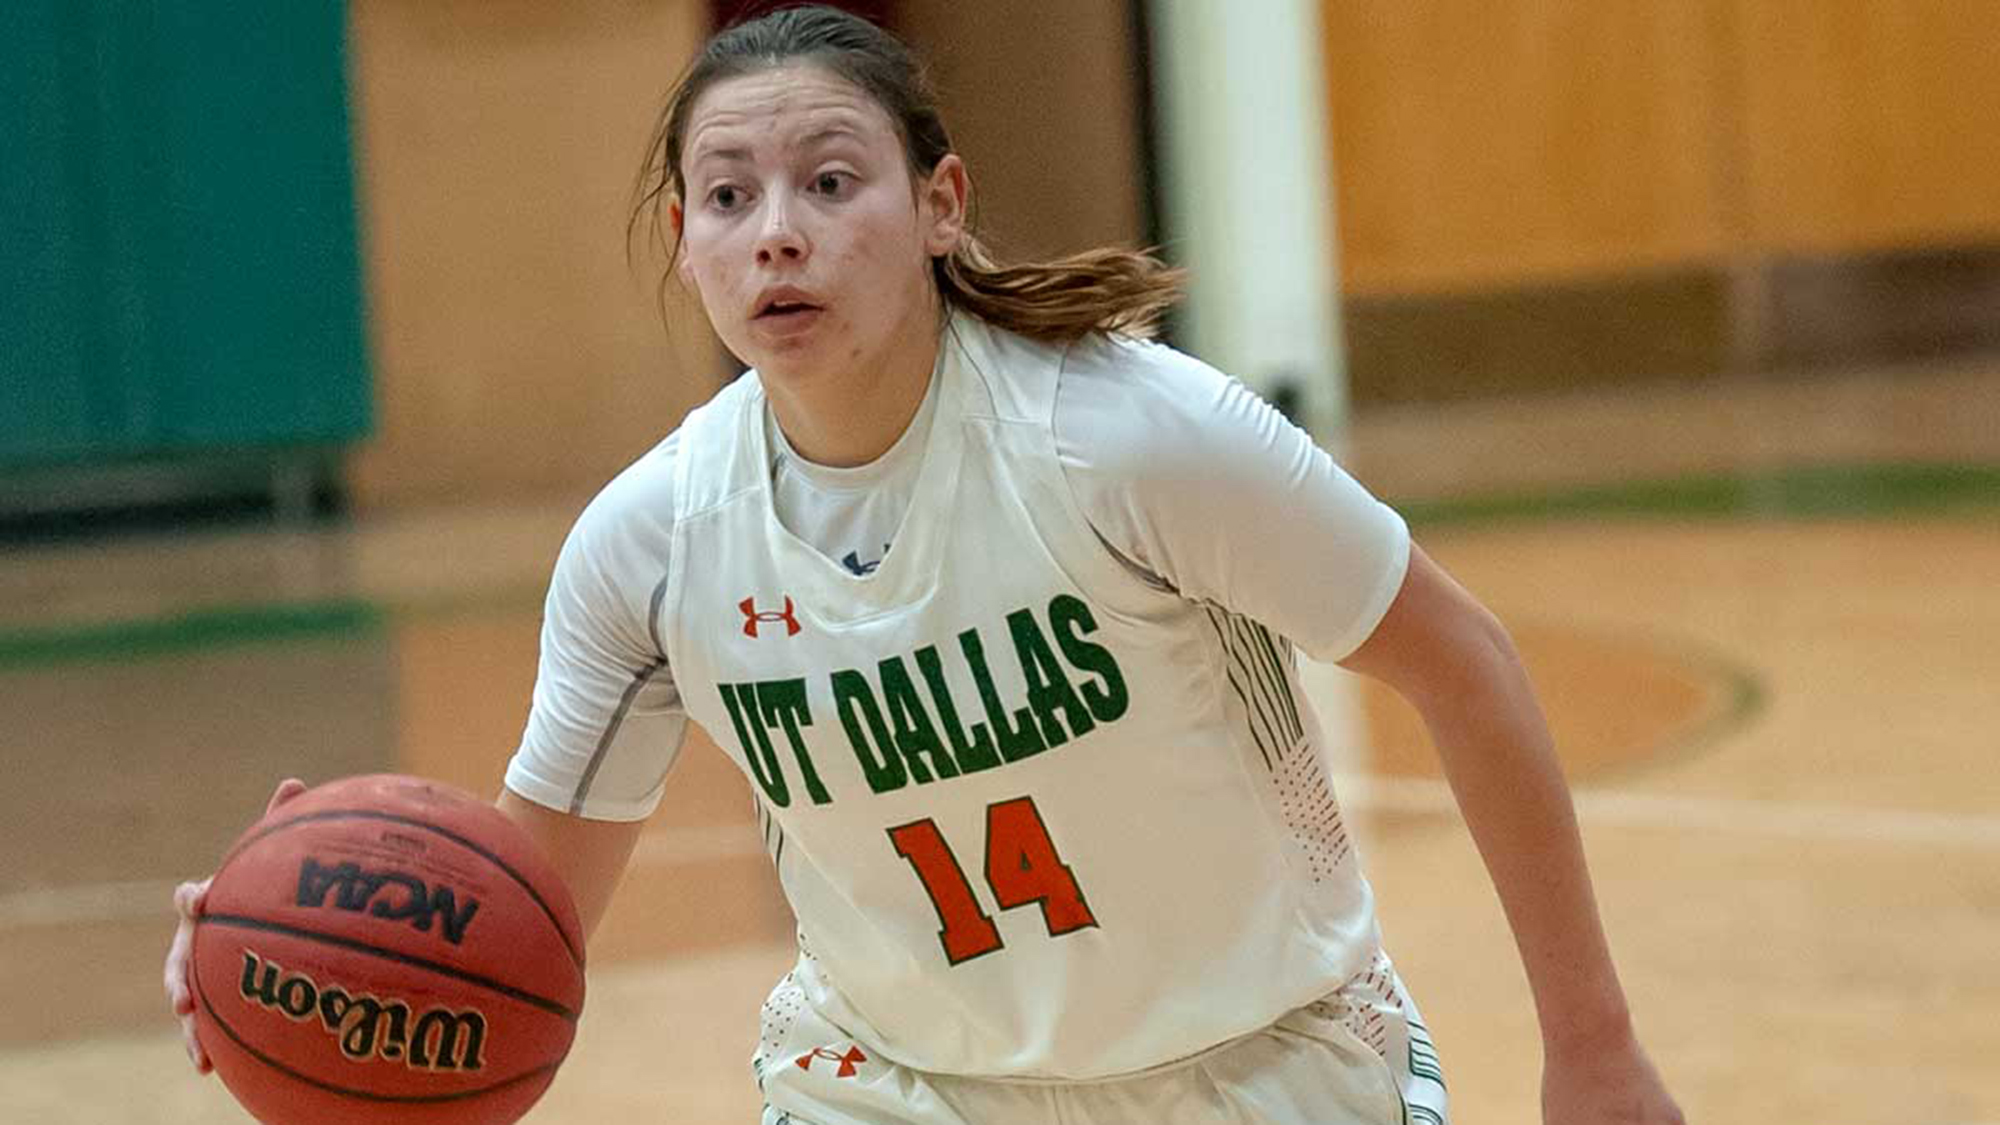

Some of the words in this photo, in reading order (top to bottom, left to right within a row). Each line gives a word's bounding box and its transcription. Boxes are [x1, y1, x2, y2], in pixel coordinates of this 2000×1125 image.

[716, 677, 834, 808] UT
[830, 594, 1130, 794] DALLAS
[295, 855, 480, 946] NCAA
[885, 795, 1100, 967] 14
[240, 948, 488, 1073] Wilson
